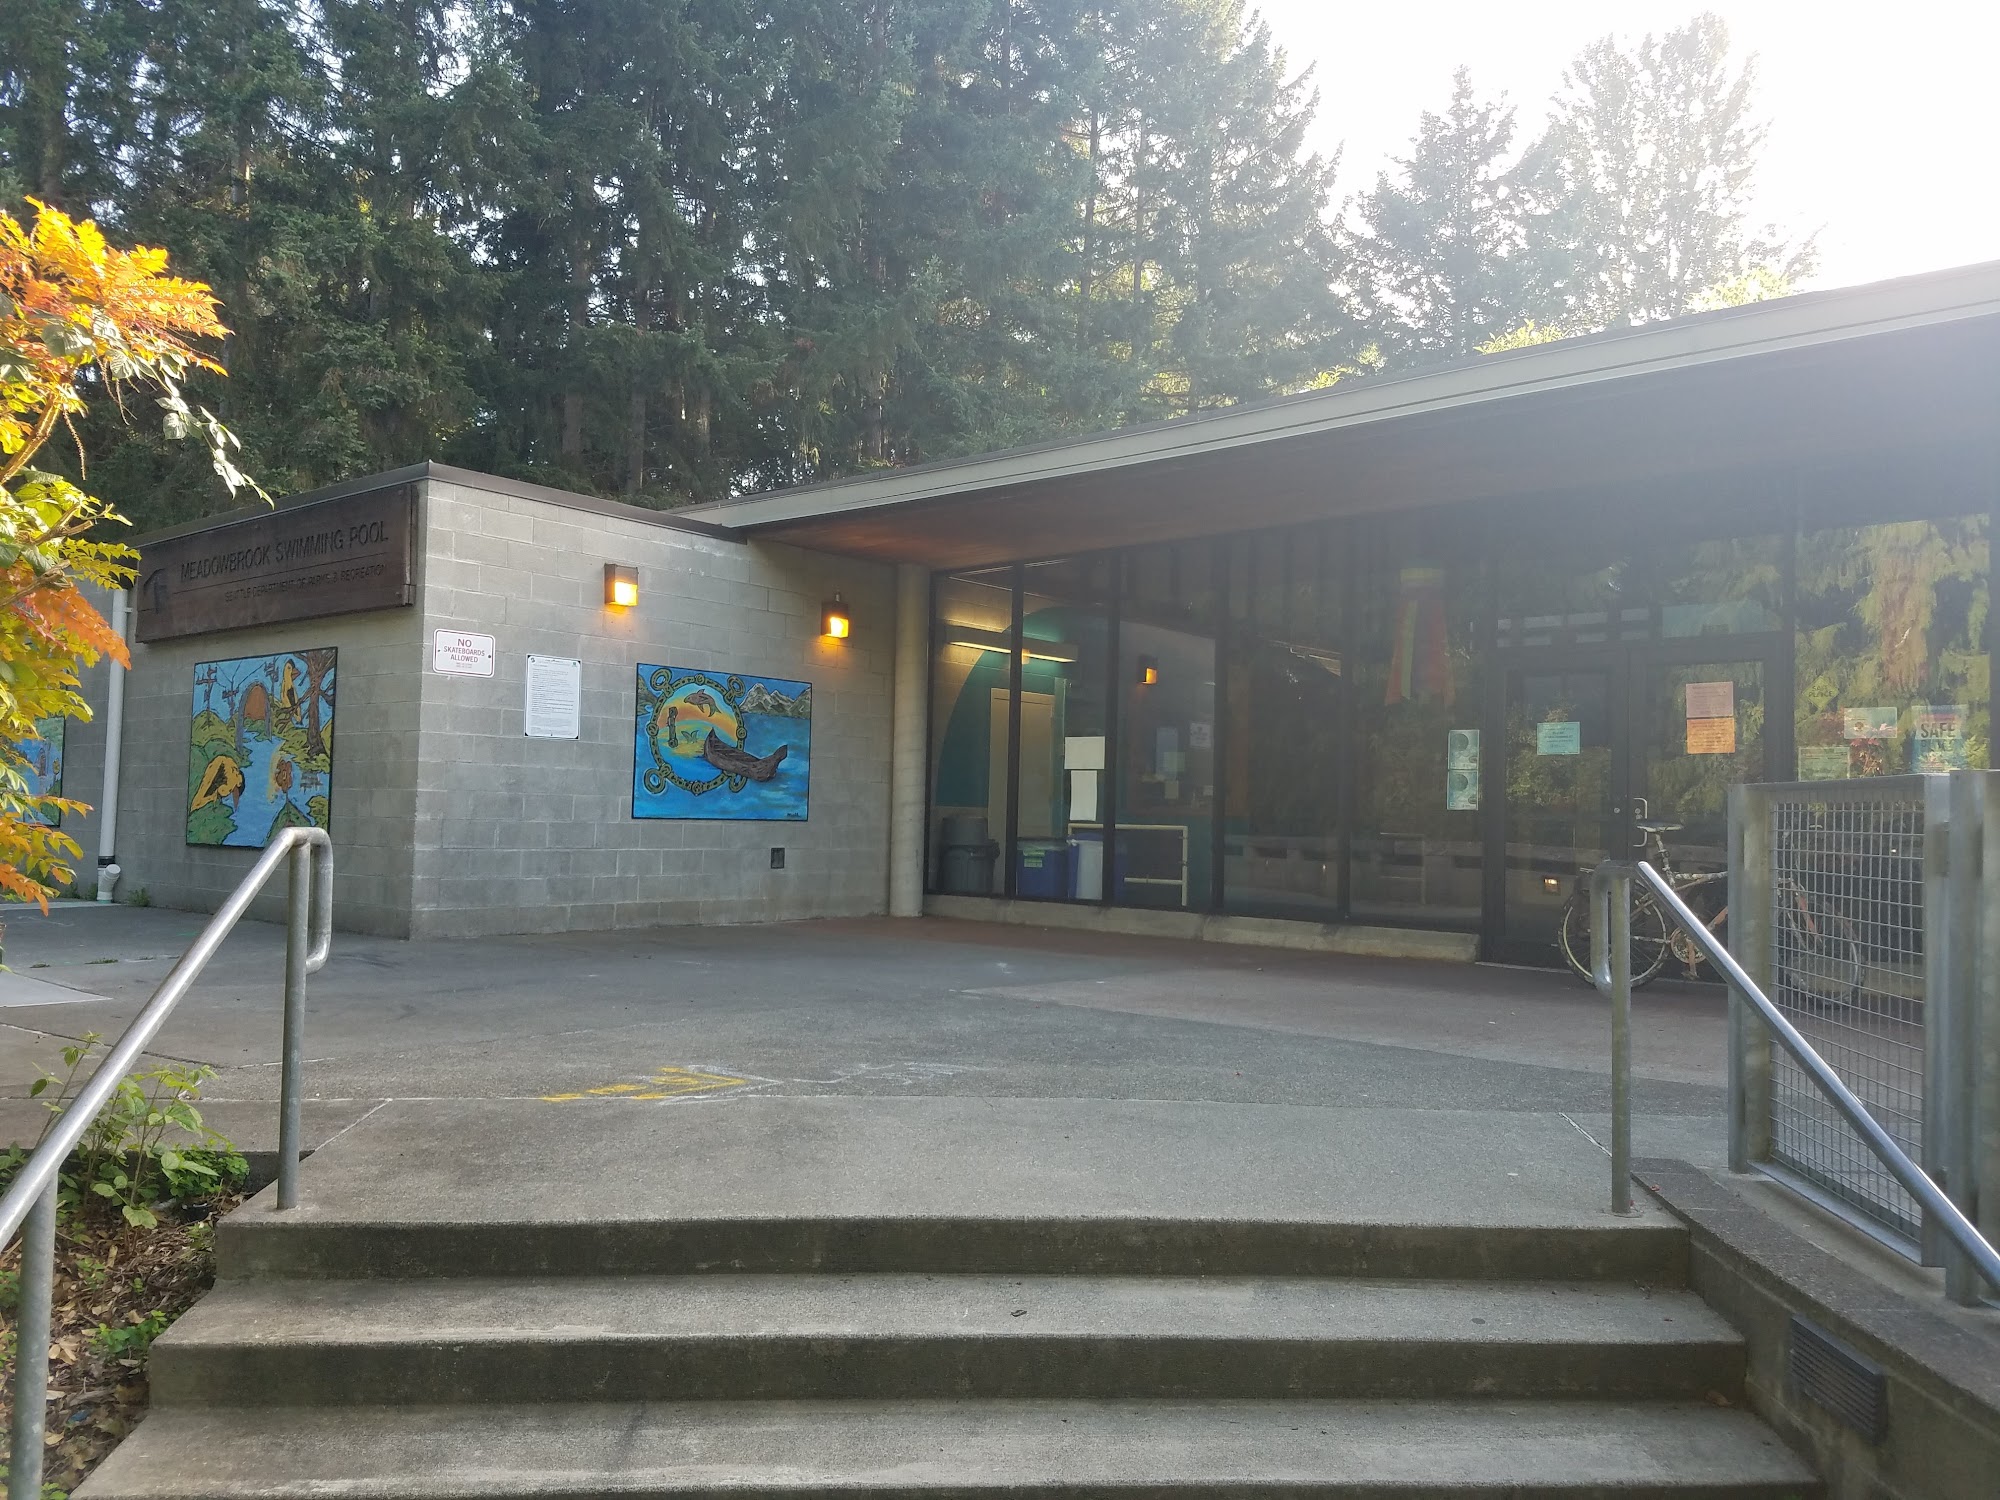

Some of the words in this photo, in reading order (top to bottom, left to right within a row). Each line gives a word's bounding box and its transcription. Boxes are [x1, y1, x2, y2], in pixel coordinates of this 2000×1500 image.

[181, 544, 270, 581] MEADOWBROOK
[275, 529, 344, 561] SWIMMING
[349, 520, 389, 547] POOL
[457, 639, 472, 648] NO
[443, 646, 485, 657] SKATEBOARDS
[450, 654, 479, 663] ALLOWED
[1920, 722, 1956, 738] SAFE
